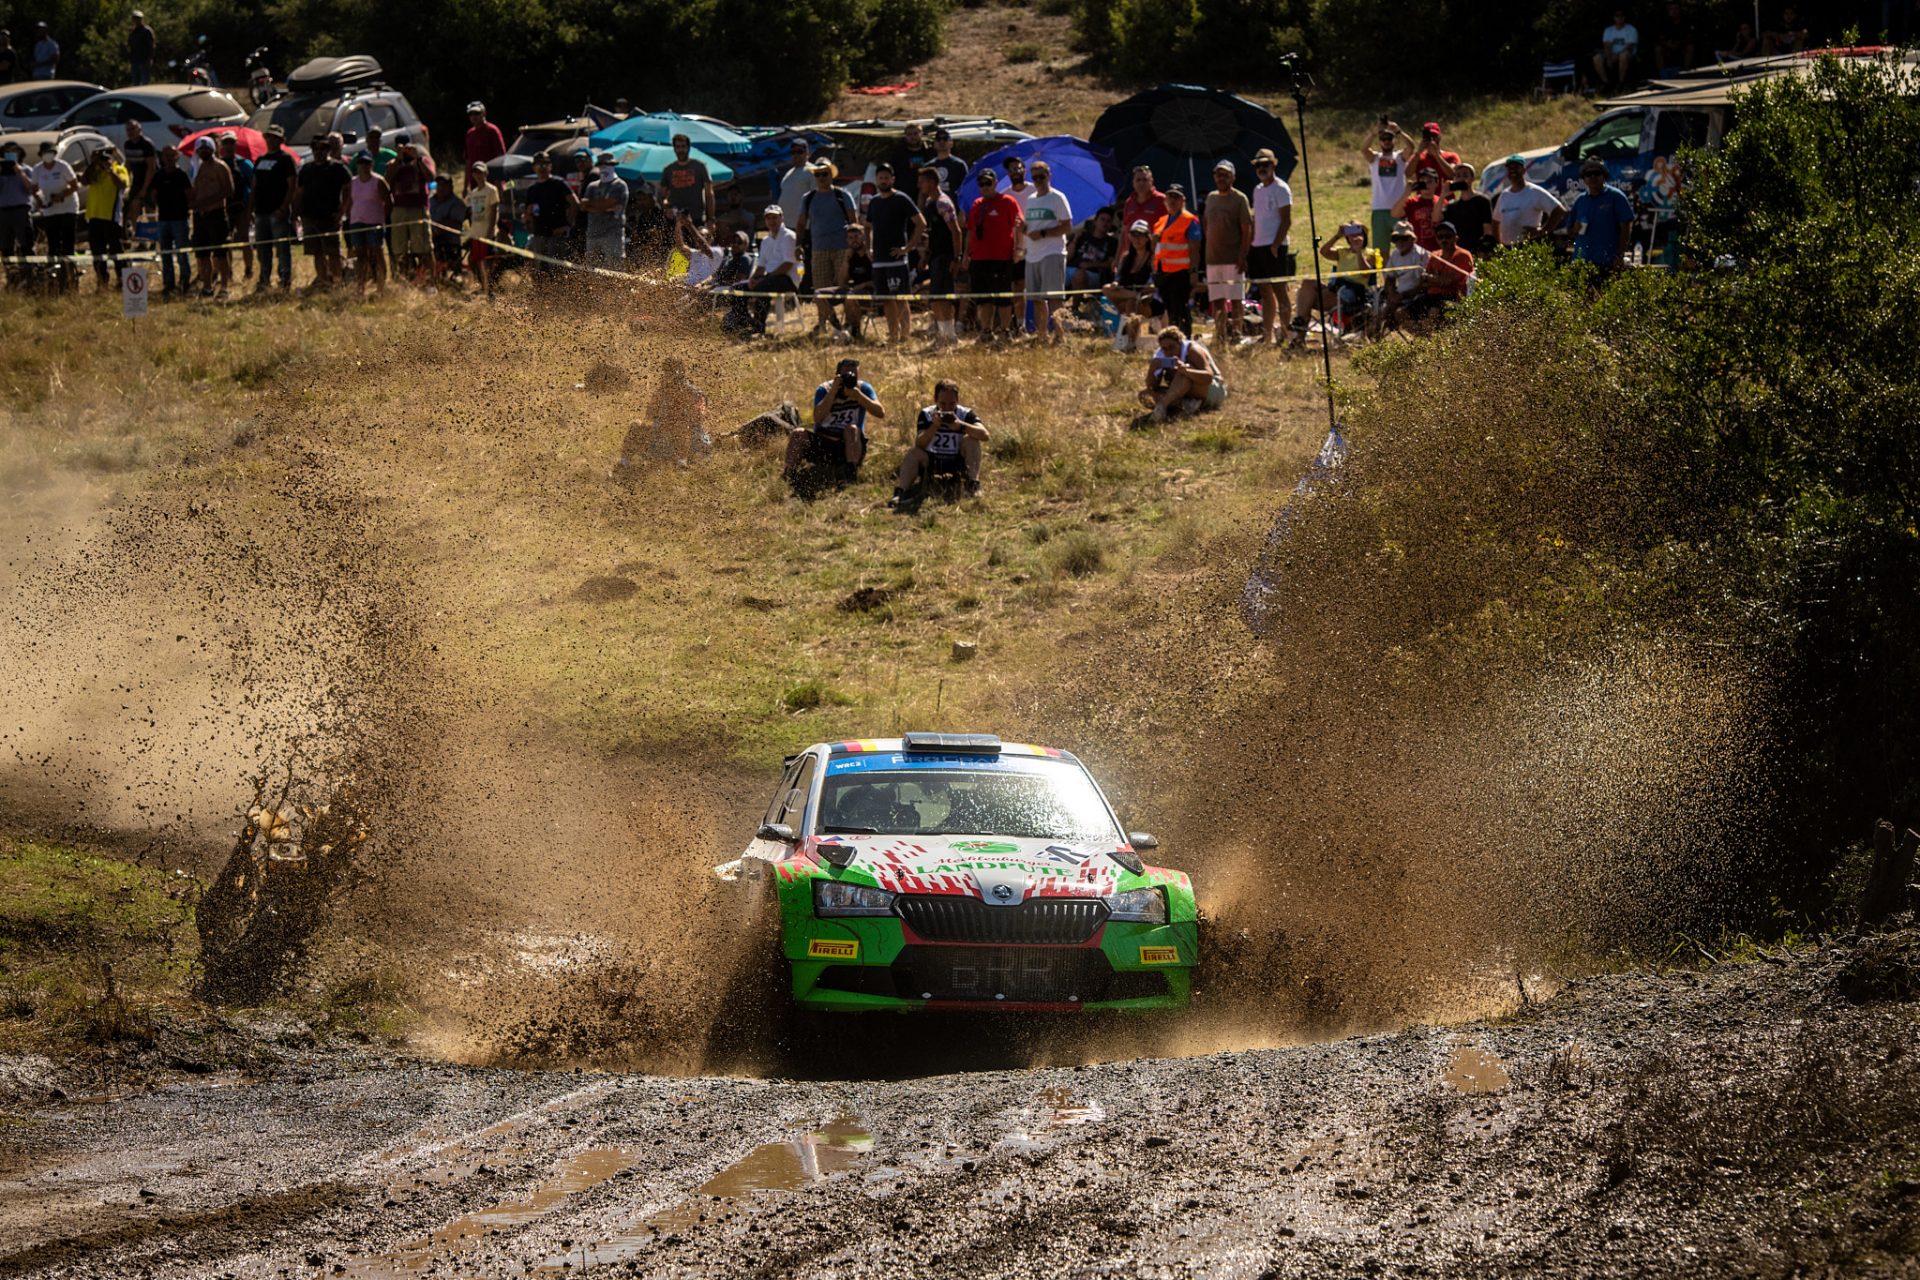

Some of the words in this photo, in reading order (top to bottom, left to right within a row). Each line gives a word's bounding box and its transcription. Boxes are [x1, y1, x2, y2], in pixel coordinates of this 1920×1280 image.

[933, 433, 957, 449] 221
[916, 862, 1075, 877] LANDPUTE
[812, 942, 855, 956] PIRELLI
[1143, 949, 1176, 961] PIRELLI
